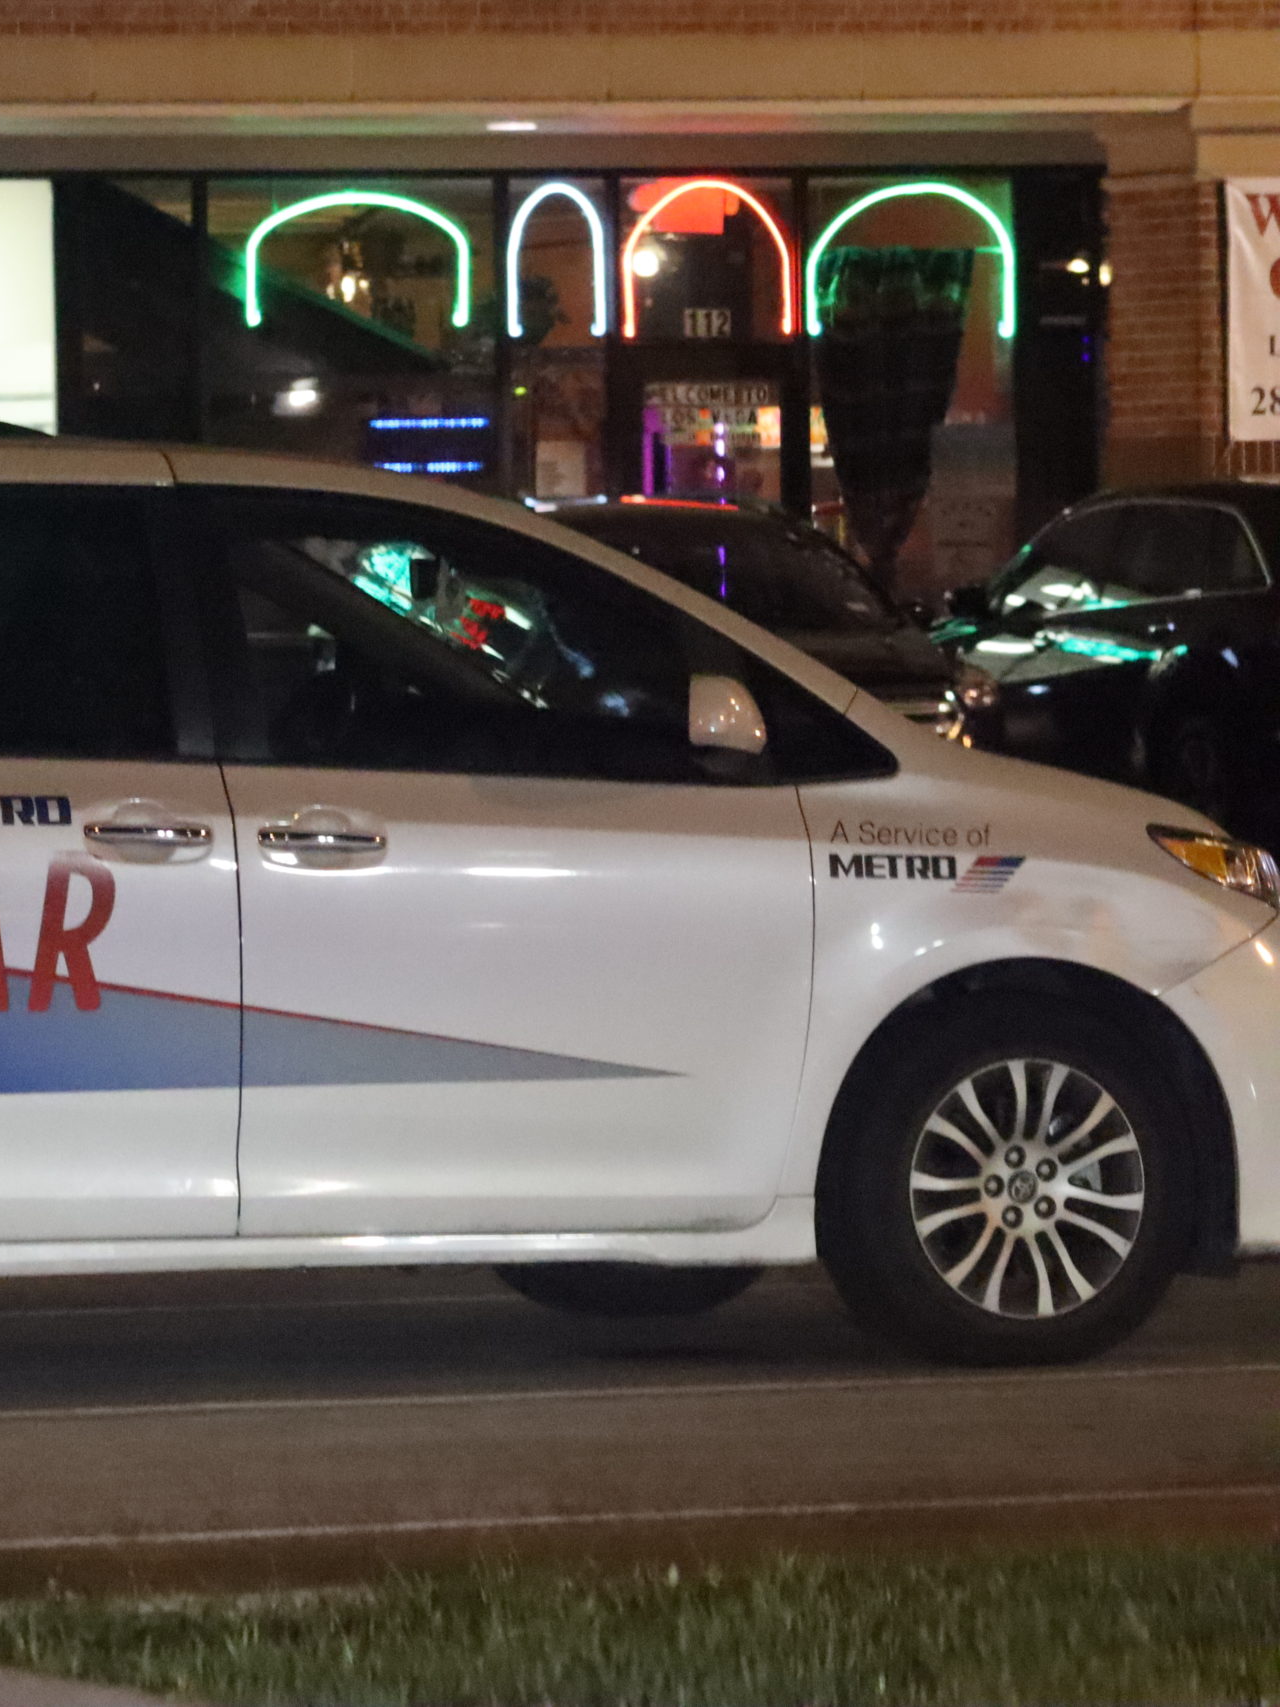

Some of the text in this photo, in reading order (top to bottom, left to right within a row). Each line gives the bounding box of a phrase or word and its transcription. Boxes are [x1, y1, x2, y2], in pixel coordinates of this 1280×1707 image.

[688, 311, 730, 336] 112
[830, 820, 992, 847] A Service of
[828, 853, 957, 880] METRO
